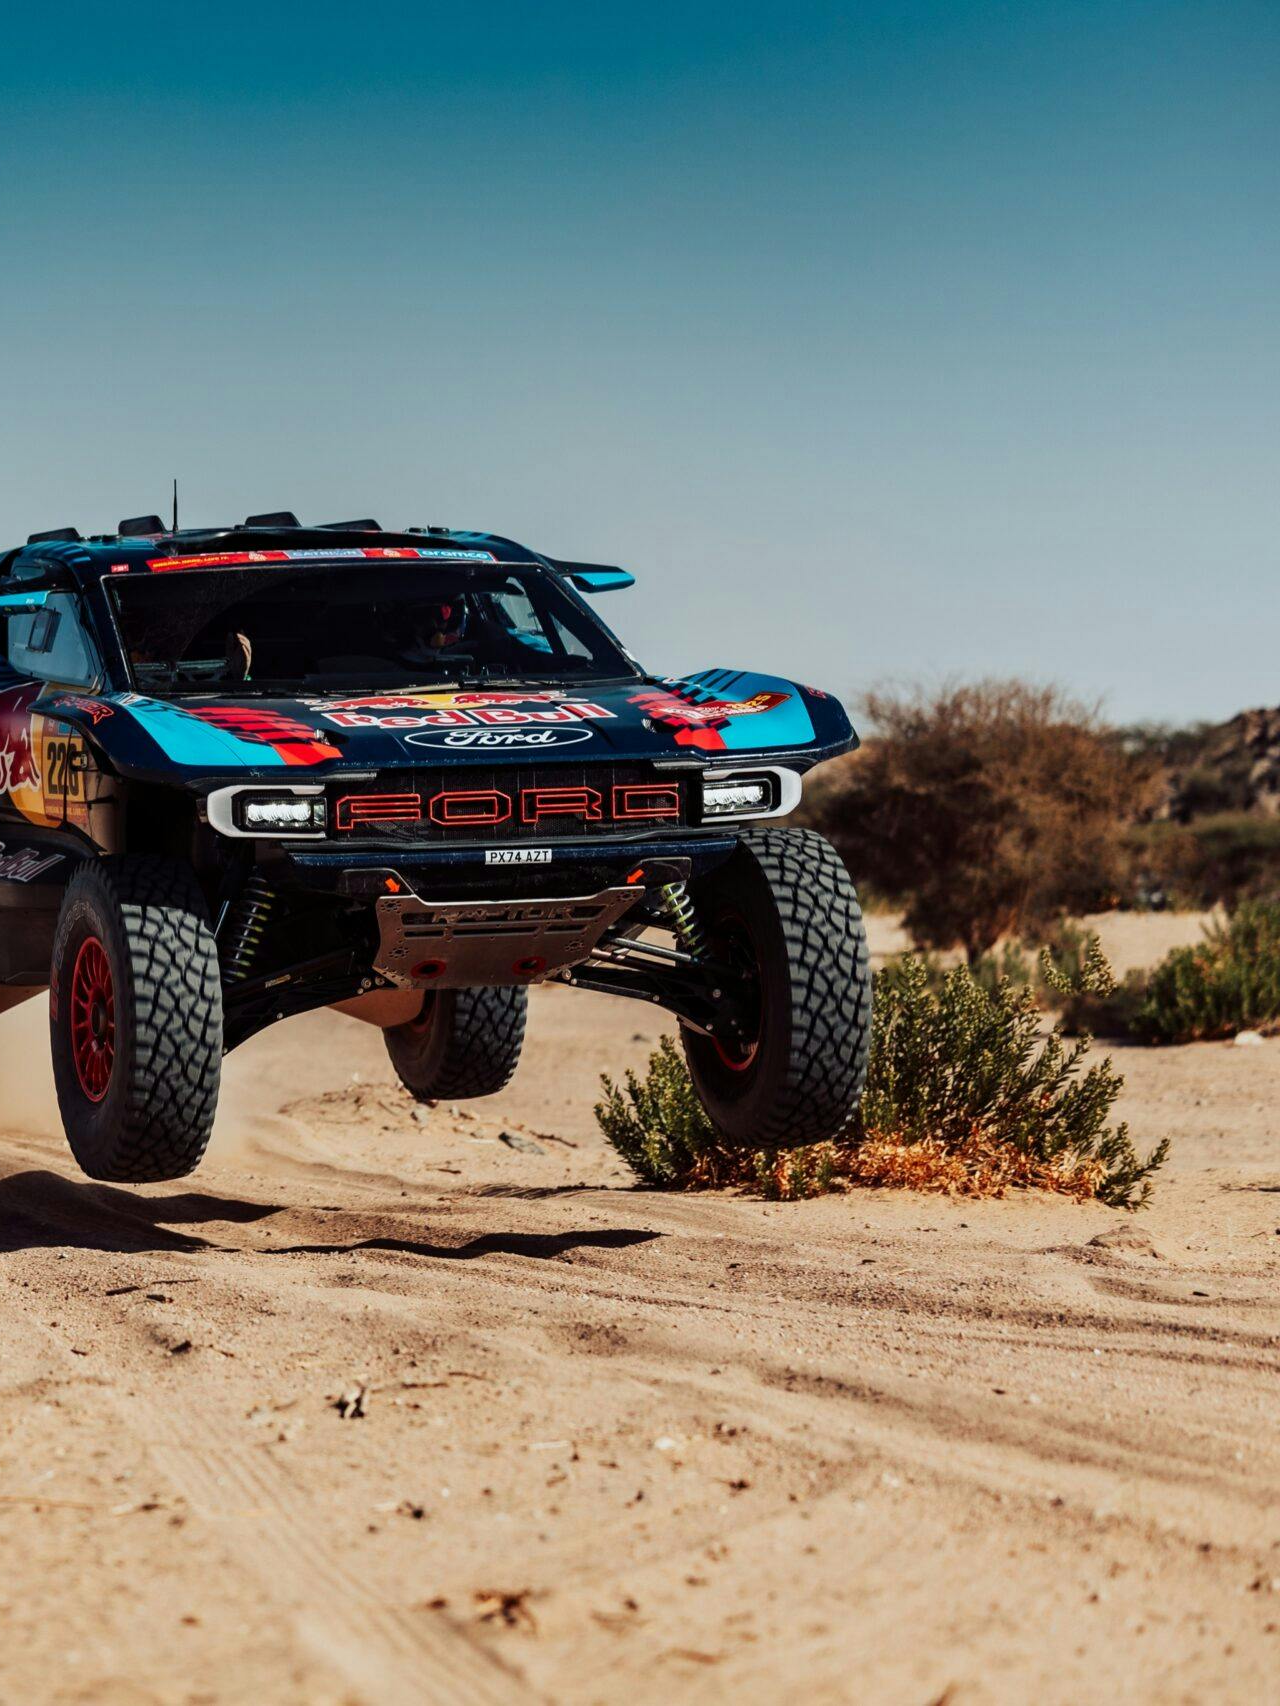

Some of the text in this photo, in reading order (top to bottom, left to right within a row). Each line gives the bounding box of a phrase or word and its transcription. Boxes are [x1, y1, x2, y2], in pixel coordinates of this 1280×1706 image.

[421, 550, 488, 559] aramco
[321, 703, 618, 729] Red Bull
[444, 729, 557, 746] Ford
[337, 783, 680, 830] FORD
[490, 851, 549, 863] PX74 AZT
